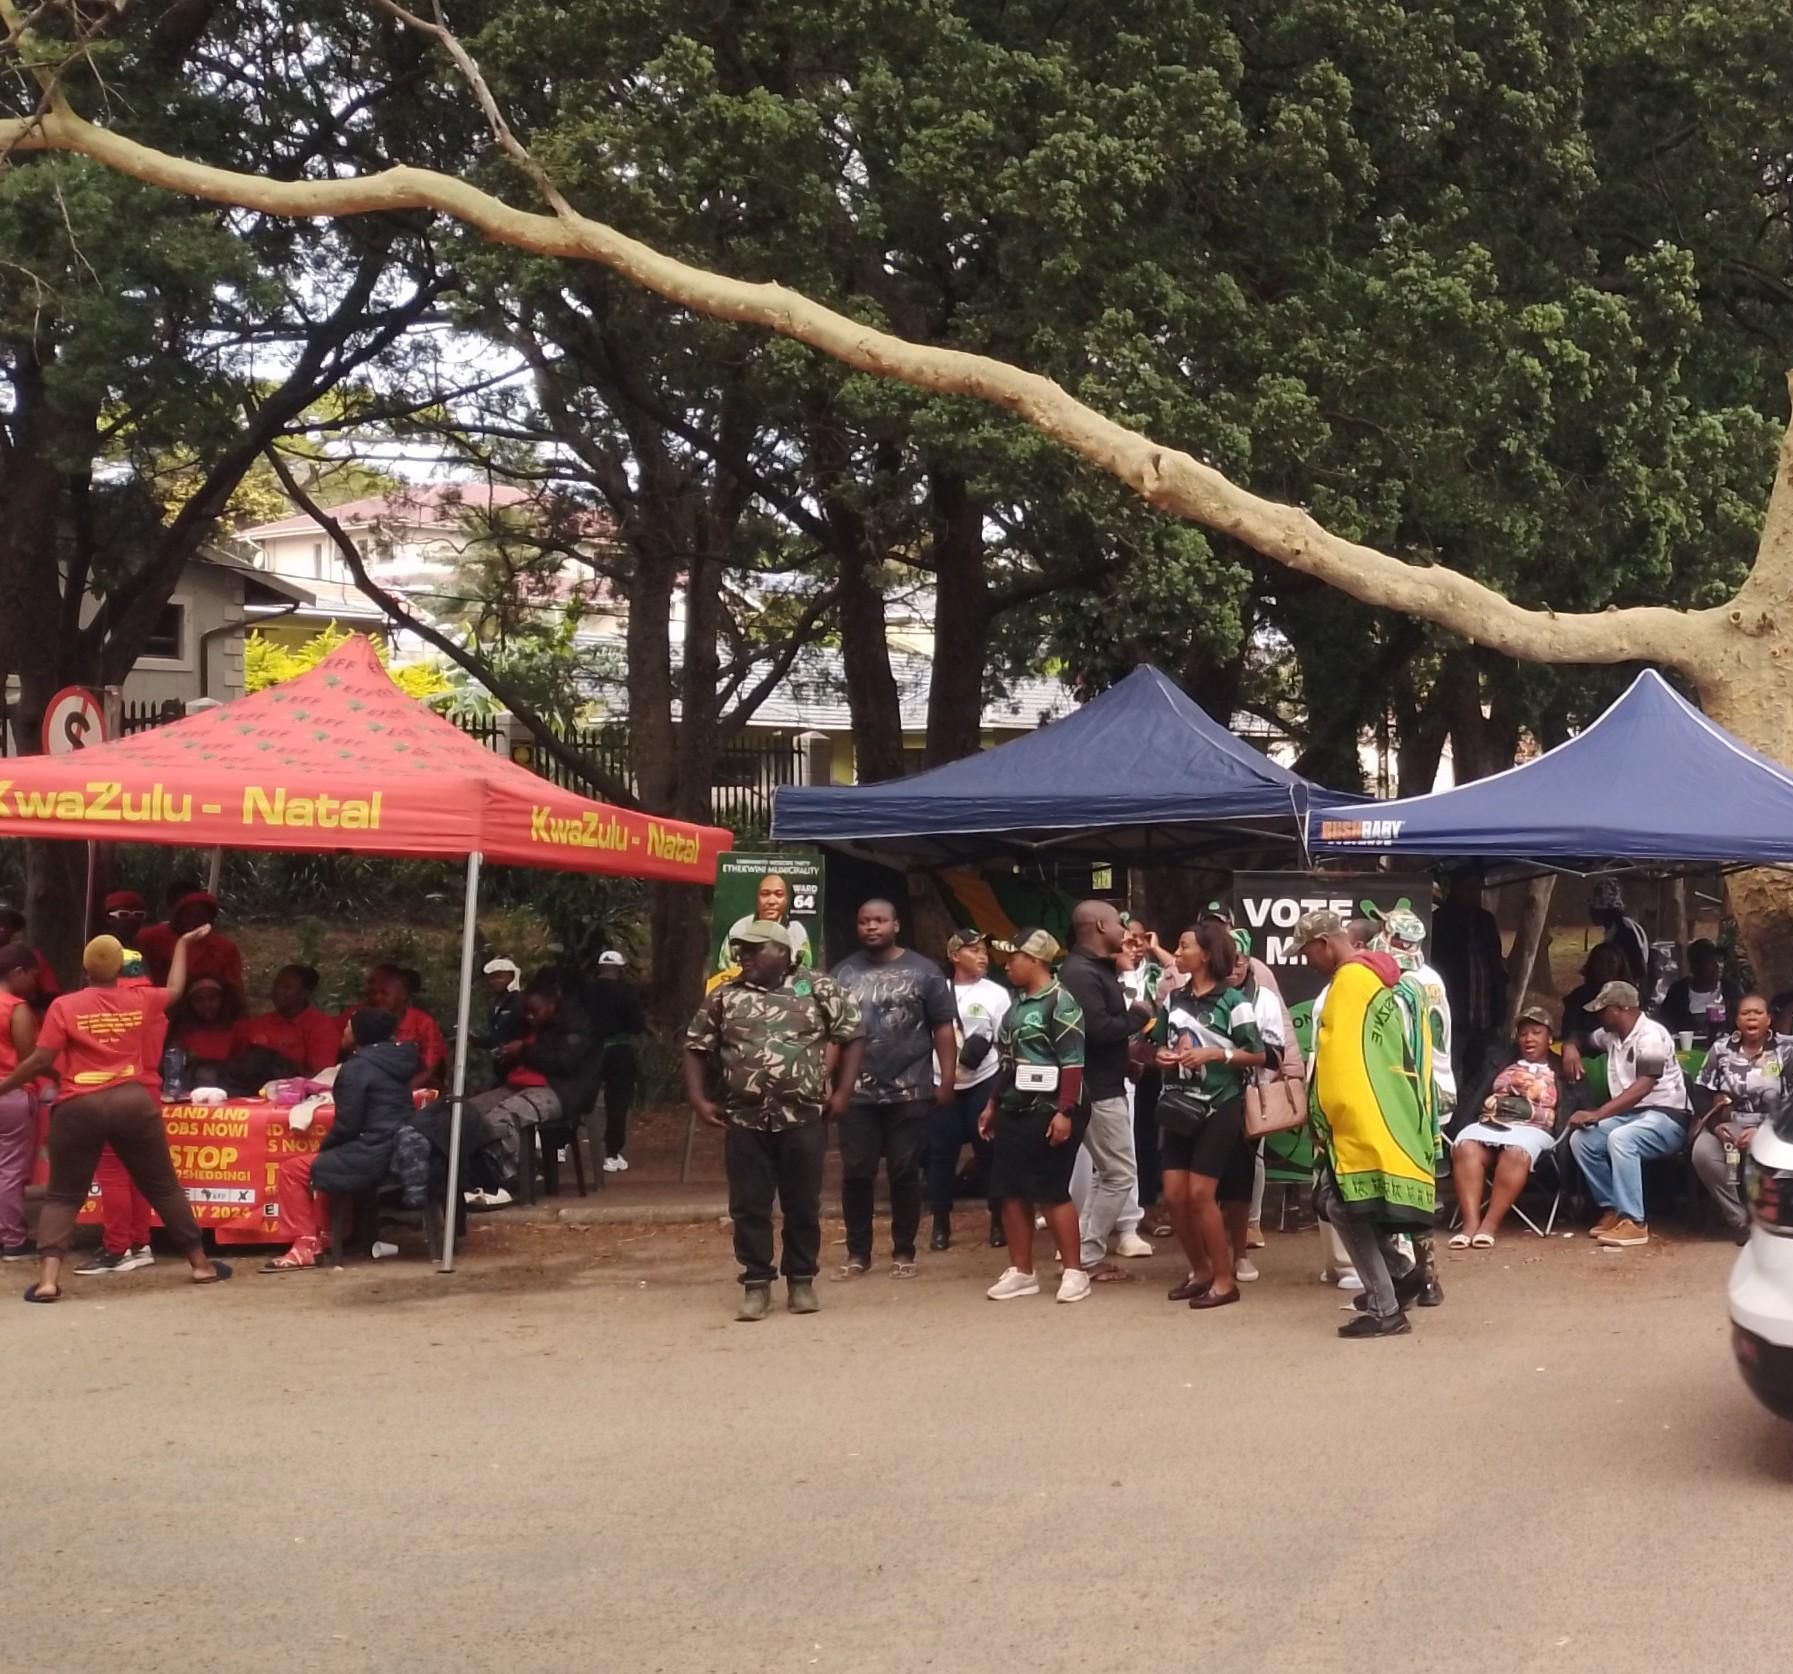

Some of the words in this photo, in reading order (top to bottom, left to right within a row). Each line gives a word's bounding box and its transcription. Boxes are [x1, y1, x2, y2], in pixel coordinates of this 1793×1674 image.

[242, 786, 382, 830] Natal
[530, 805, 628, 851] KwaZulu
[647, 822, 699, 864] Natal
[1321, 820, 1402, 840] BUSHBABY
[722, 863, 767, 874] ETHEKWINI
[767, 864, 819, 875] MUNICIPALITY
[792, 883, 818, 894] WARD
[793, 894, 815, 910] 64
[162, 1106, 209, 1120] LAND
[212, 1107, 250, 1121] AND
[166, 1122, 199, 1135] OBS
[202, 1122, 249, 1138] NOW!
[168, 1144, 239, 1170] STOP
